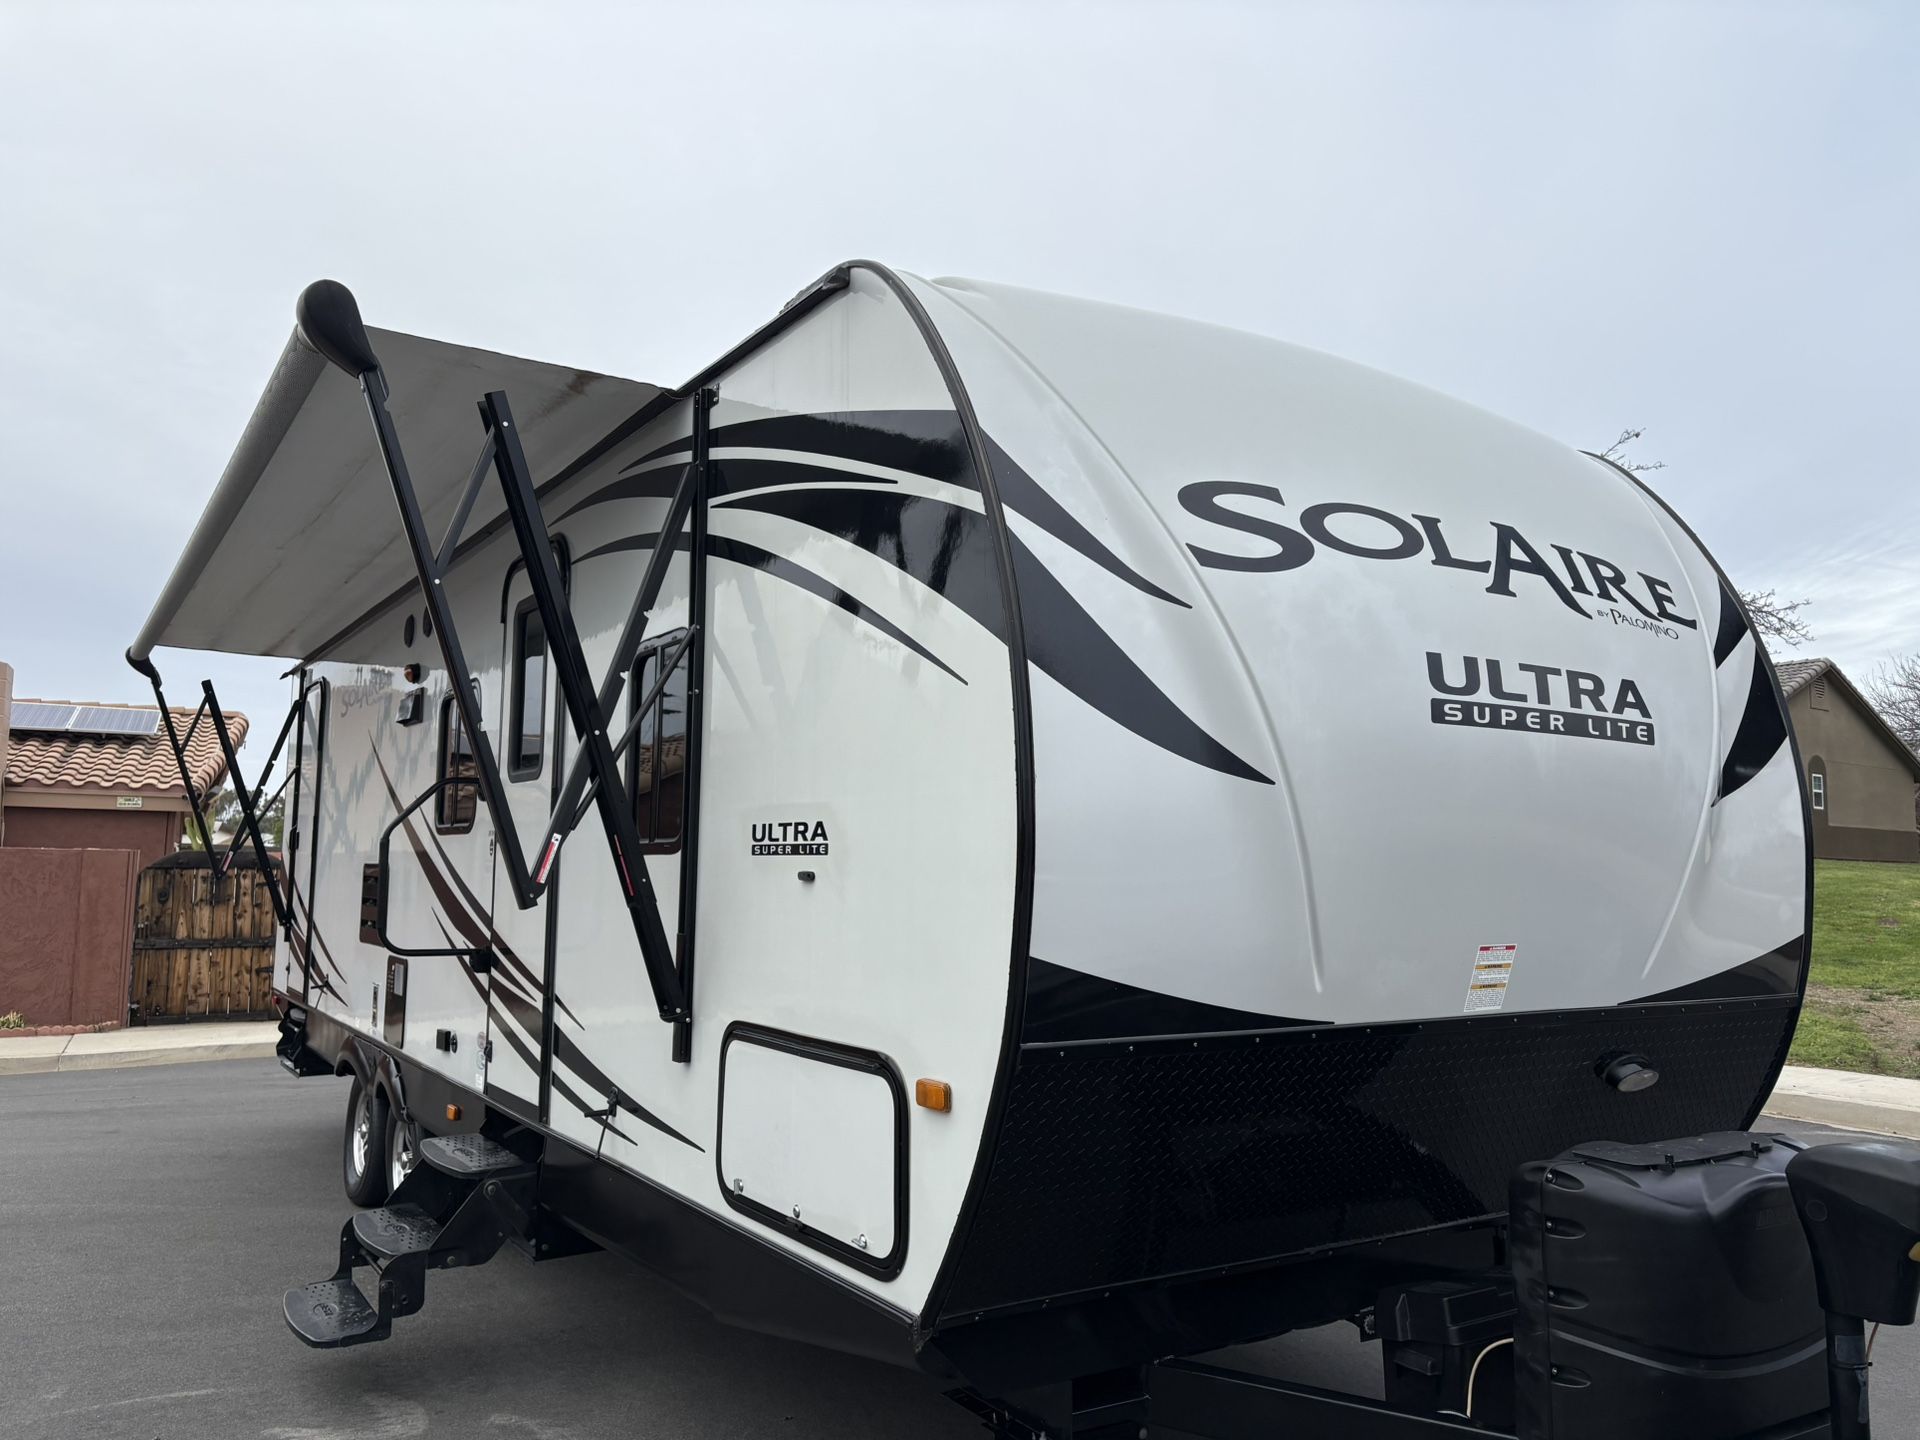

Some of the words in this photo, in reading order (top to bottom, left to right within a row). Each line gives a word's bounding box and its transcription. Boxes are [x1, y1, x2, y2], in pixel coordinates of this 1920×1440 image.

[1177, 480, 1697, 630] SOLAIRE
[1597, 610, 1609, 618] BY
[1610, 608, 1679, 640] PALOMINO
[1426, 652, 1652, 719] ULTRA
[1443, 703, 1565, 732] SUPER
[1588, 718, 1649, 742] LITE
[752, 821, 829, 843] ULTRA
[754, 846, 792, 855] SUPER
[799, 845, 826, 854] LITE
